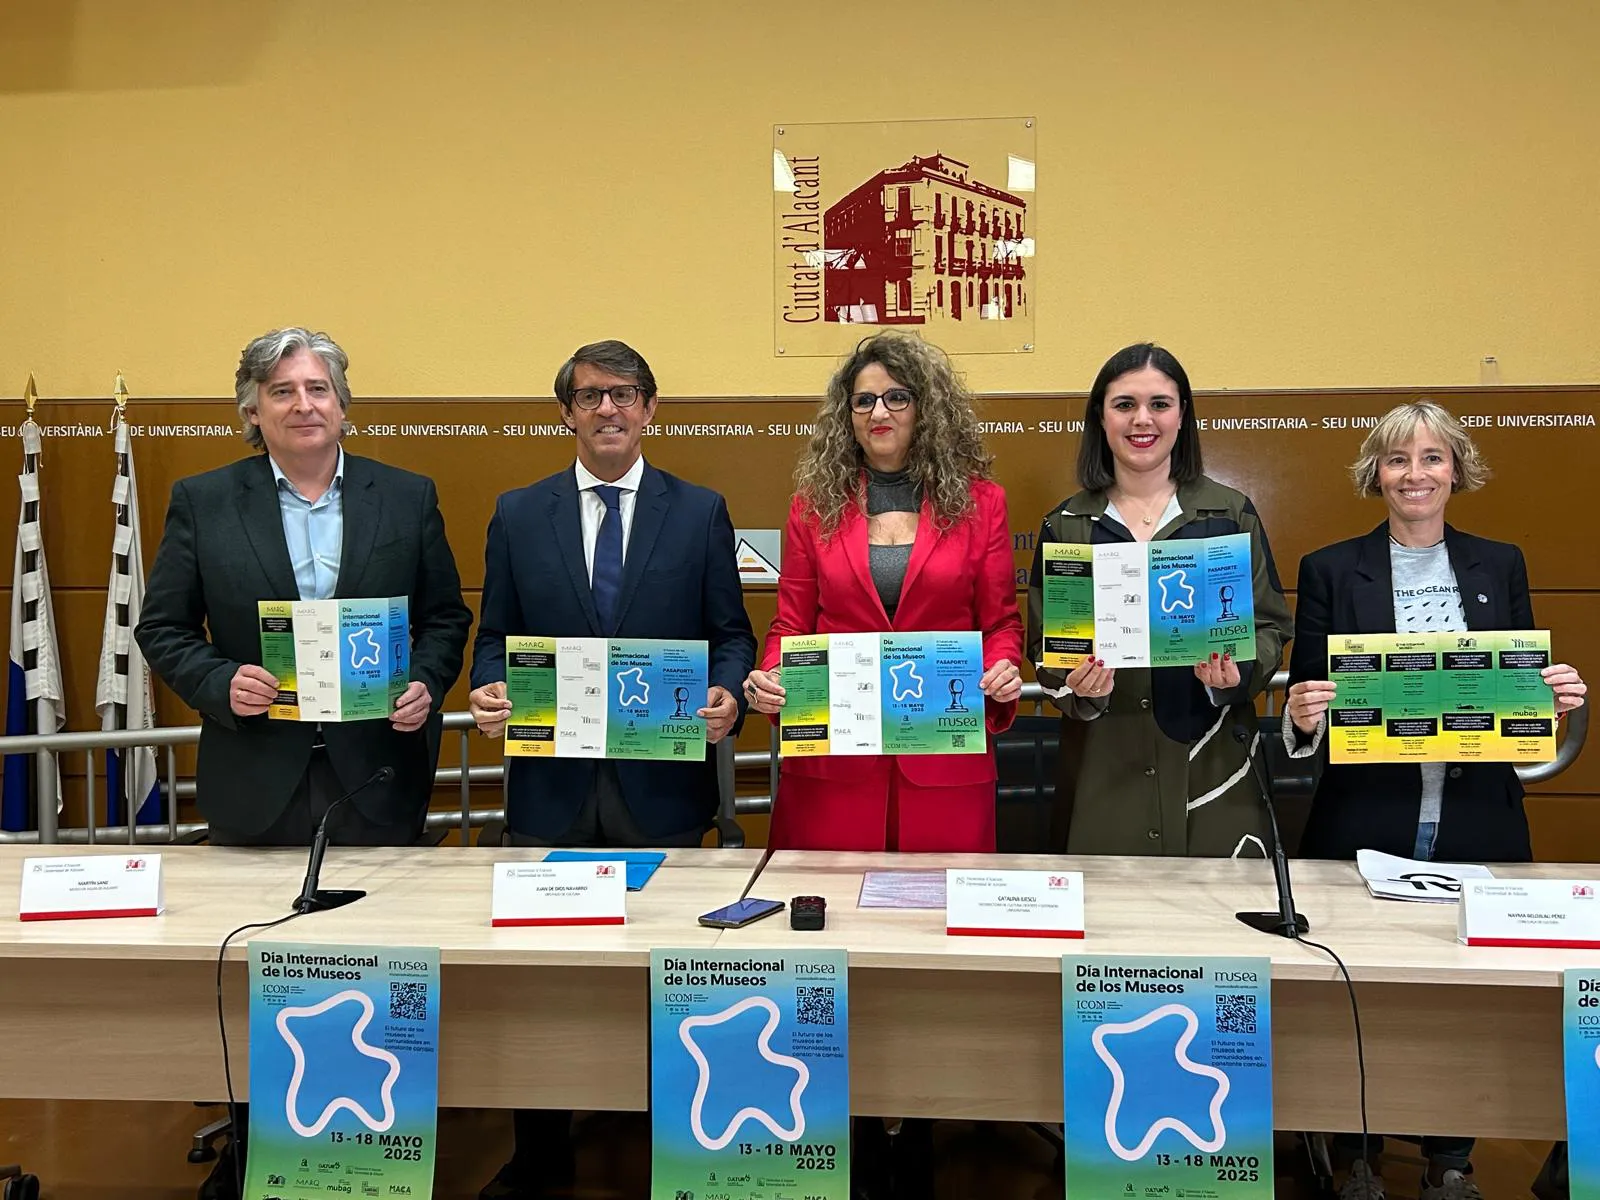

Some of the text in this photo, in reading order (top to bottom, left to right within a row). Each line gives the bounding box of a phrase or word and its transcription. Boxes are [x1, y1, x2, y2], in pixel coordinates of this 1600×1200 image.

[782, 156, 820, 323] Ciutat d'Alacant
[1212, 416, 1382, 430] UNIVERSITARIA SEU UNIV
[1498, 414, 1596, 427] UNIVERSITARIA
[0, 423, 233, 436] EU VERSITÀRIA DE UNIVERSITARIA
[400, 425, 488, 436] UNIVERSITARIA
[503, 425, 526, 436] SEU
[530, 425, 576, 436] UNIVER
[666, 425, 754, 436] UNIVERSITARIA
[768, 424, 790, 435] SEU
[1039, 422, 1062, 432] SEU
[1416, 586, 1451, 595] OCEAN
[1210, 624, 1248, 637] musea
[938, 717, 977, 726] musea
[662, 724, 699, 734] musea
[261, 952, 378, 967] Día Internacional
[388, 961, 428, 970] musea
[664, 958, 784, 971] Día Internacional
[262, 966, 361, 980] de los Museos
[795, 964, 835, 974] musea
[1076, 965, 1203, 979] Día Internacional
[664, 974, 767, 986] de los Museos
[1214, 971, 1257, 982] musea
[263, 984, 289, 994] ICOM
[1076, 981, 1184, 994] de los Museos
[665, 994, 692, 1002] ICOM
[1578, 995, 1599, 1007] de
[1076, 1000, 1105, 1009] ICOM
[1579, 1016, 1600, 1025] ICO
[331, 1132, 343, 1143] 13
[355, 1133, 373, 1145] 18
[379, 1135, 423, 1148] MAYO
[384, 1148, 422, 1161] 2025
[739, 1144, 752, 1155] 13
[765, 1144, 783, 1155] 18
[790, 1145, 836, 1156] MAYO
[796, 1158, 836, 1170] 2025
[1156, 1154, 1170, 1166] 13
[1184, 1155, 1203, 1166] 18
[1210, 1156, 1259, 1168] MAYO
[1217, 1170, 1258, 1182] 2025
[327, 1185, 351, 1194] mubag
